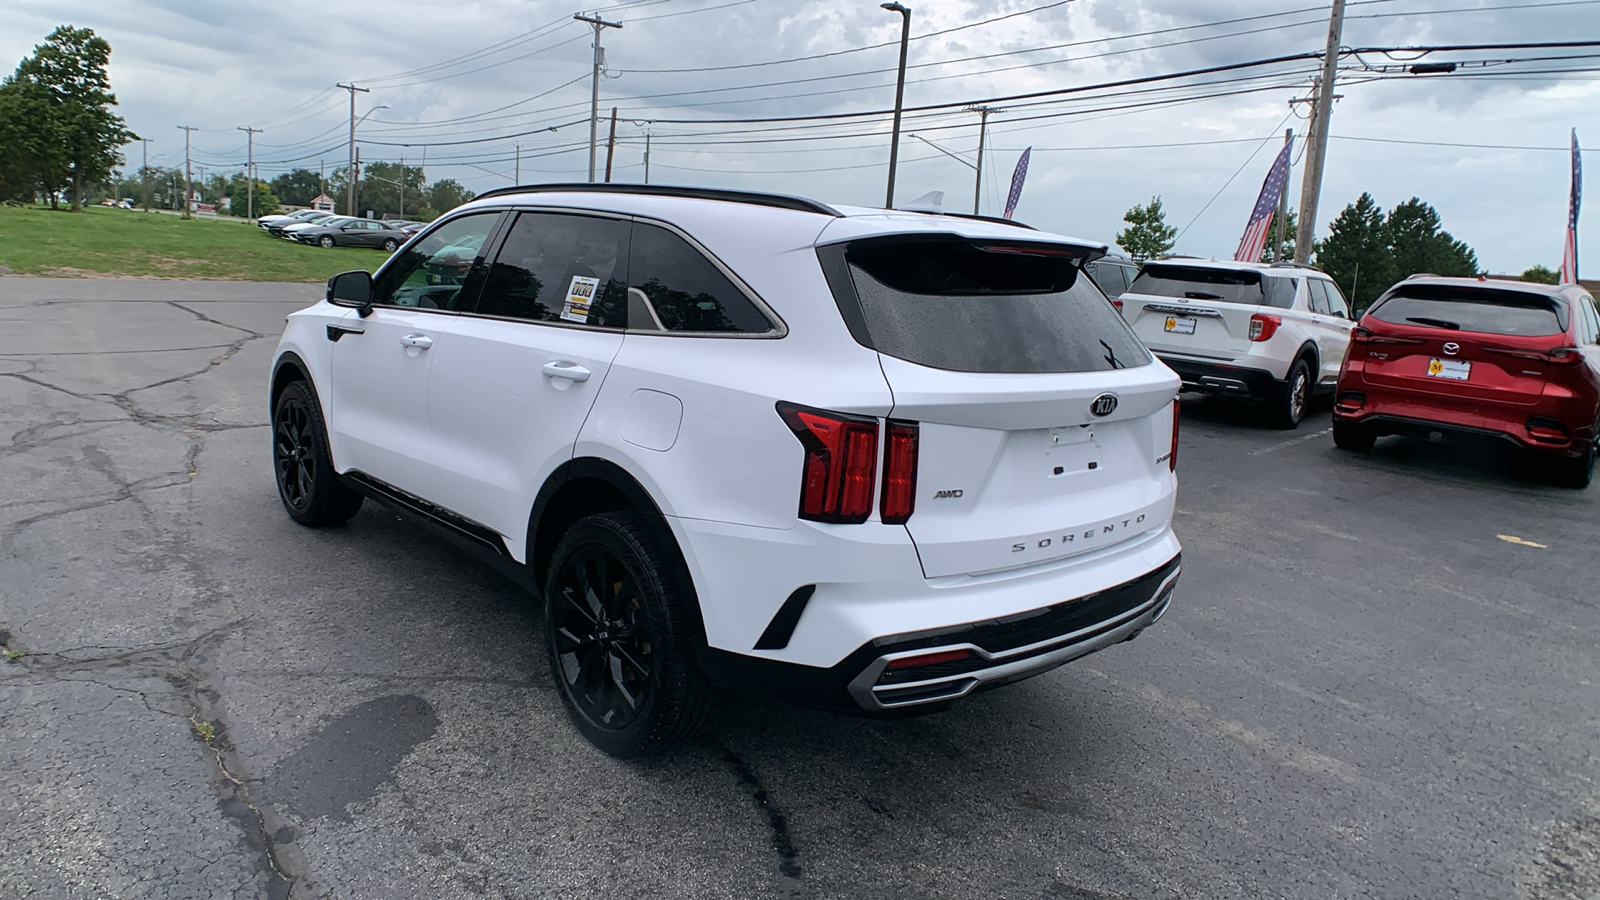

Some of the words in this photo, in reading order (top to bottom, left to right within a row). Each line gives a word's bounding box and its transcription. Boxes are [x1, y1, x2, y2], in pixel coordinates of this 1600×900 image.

[1095, 398, 1116, 413] KIA
[932, 489, 963, 499] AWD
[1011, 514, 1146, 552] SORENTO
